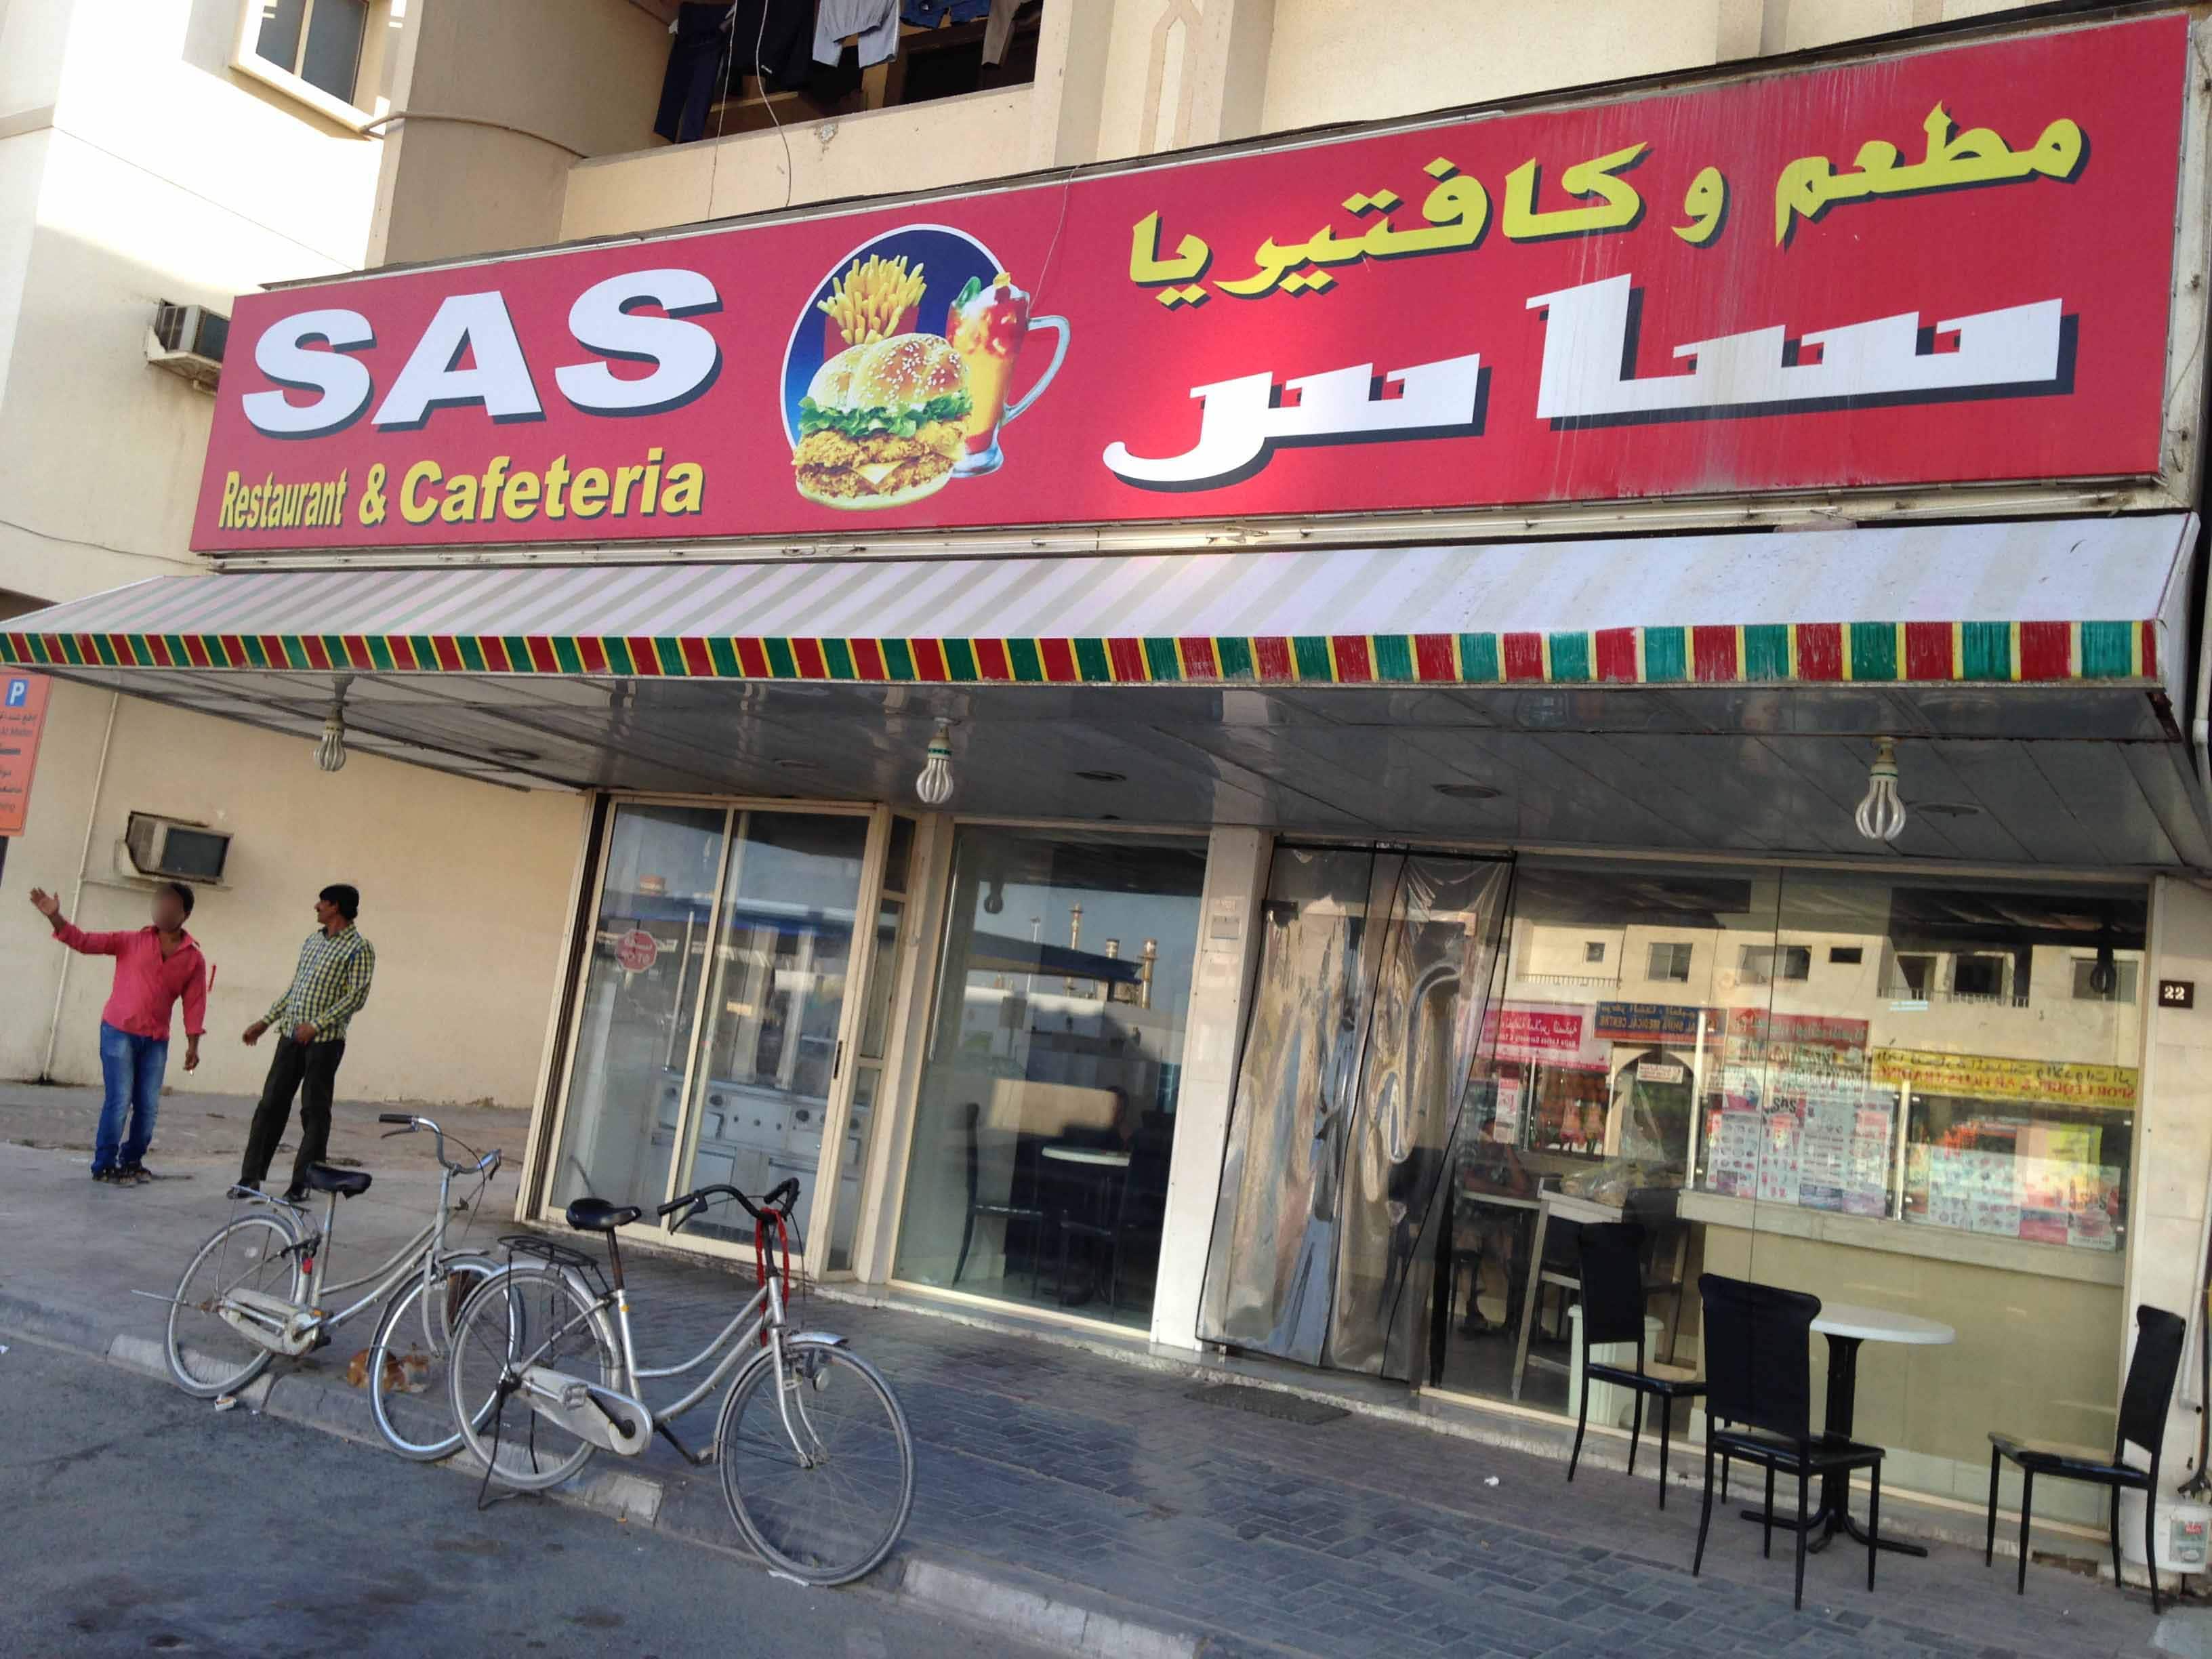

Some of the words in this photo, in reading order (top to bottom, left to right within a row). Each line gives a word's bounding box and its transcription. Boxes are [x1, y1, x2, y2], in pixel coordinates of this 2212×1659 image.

[1128, 141, 1650, 309] كافتيريا
[1671, 165, 1727, 245] و
[1775, 100, 2085, 249] مطعم
[241, 268, 721, 437] SAS
[1102, 272, 2067, 488] ساس
[218, 466, 348, 529] Restaurant
[358, 462, 389, 527] &
[399, 446, 705, 525] Cafeteria
[2164, 985, 2185, 1000] 22
